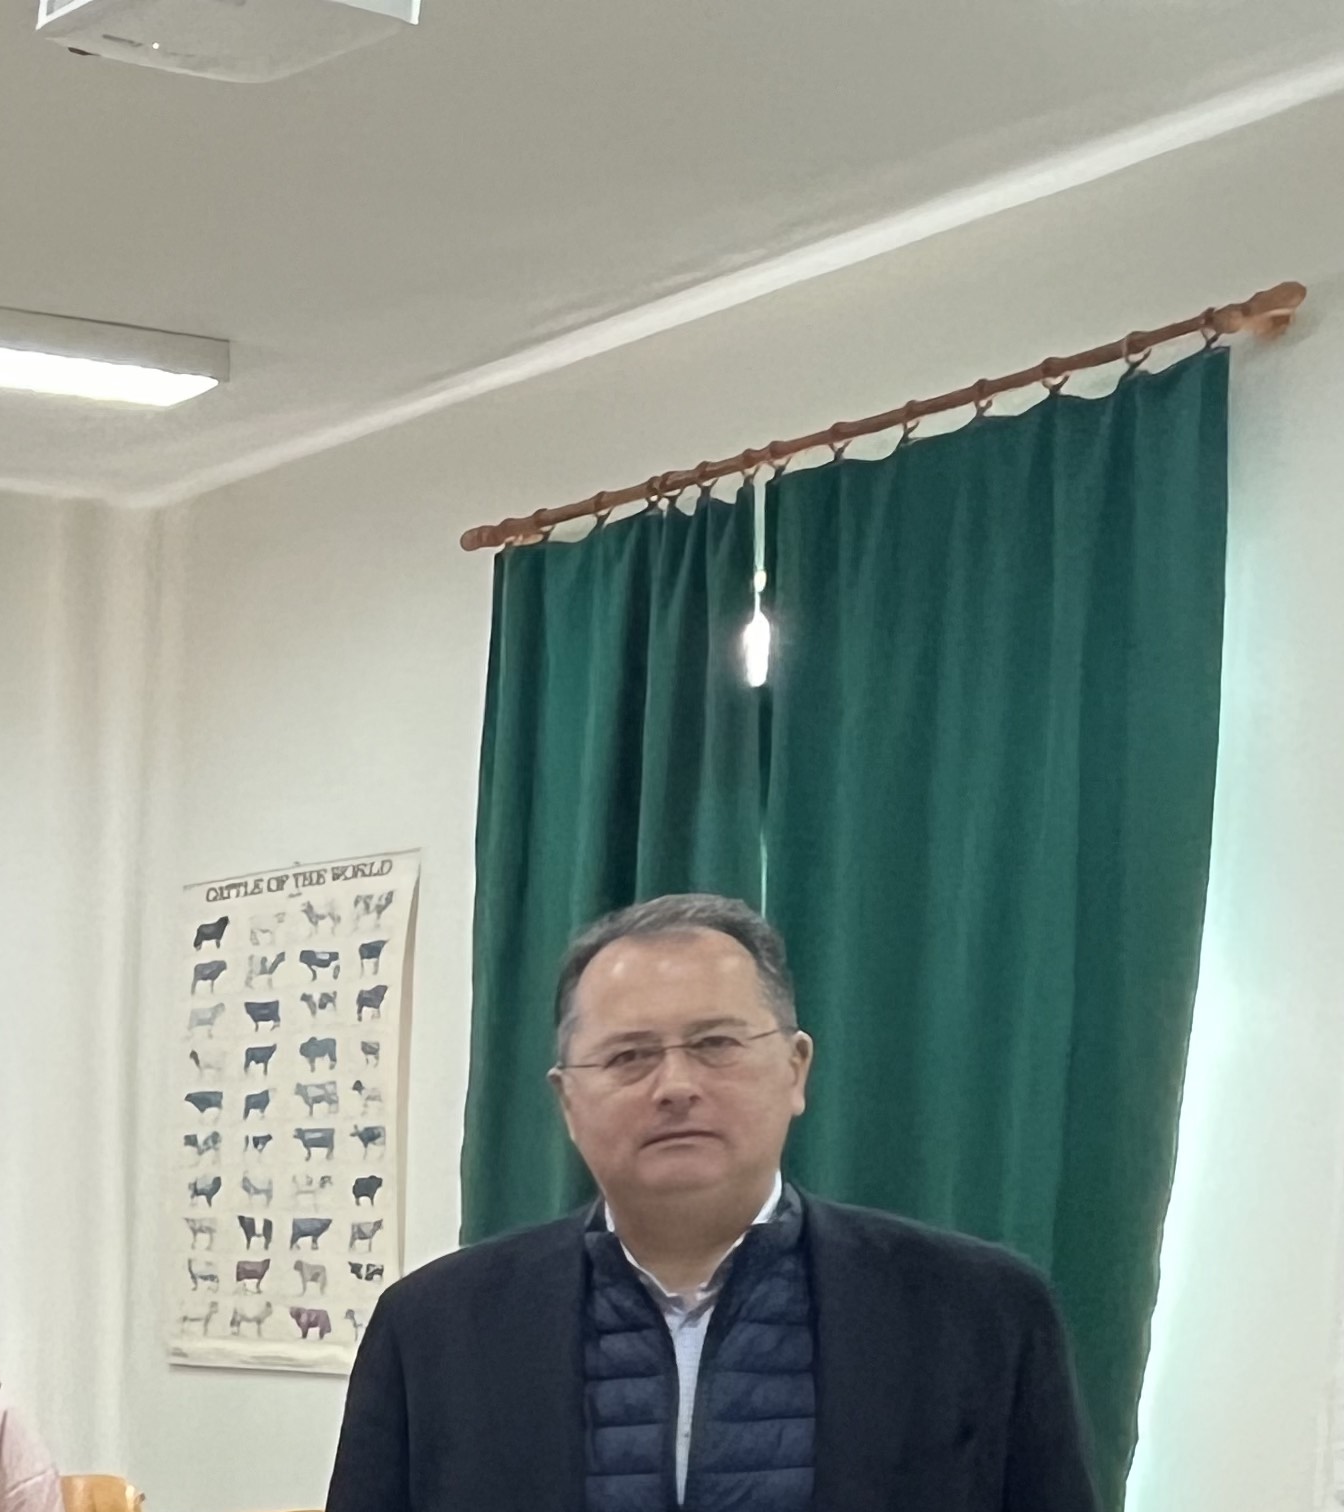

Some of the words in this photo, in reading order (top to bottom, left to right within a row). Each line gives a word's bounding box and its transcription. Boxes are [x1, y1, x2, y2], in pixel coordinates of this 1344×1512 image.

[205, 879, 263, 902] CATTLE
[267, 874, 290, 893] OF
[292, 868, 327, 889] THE
[331, 859, 393, 882] WORLD
